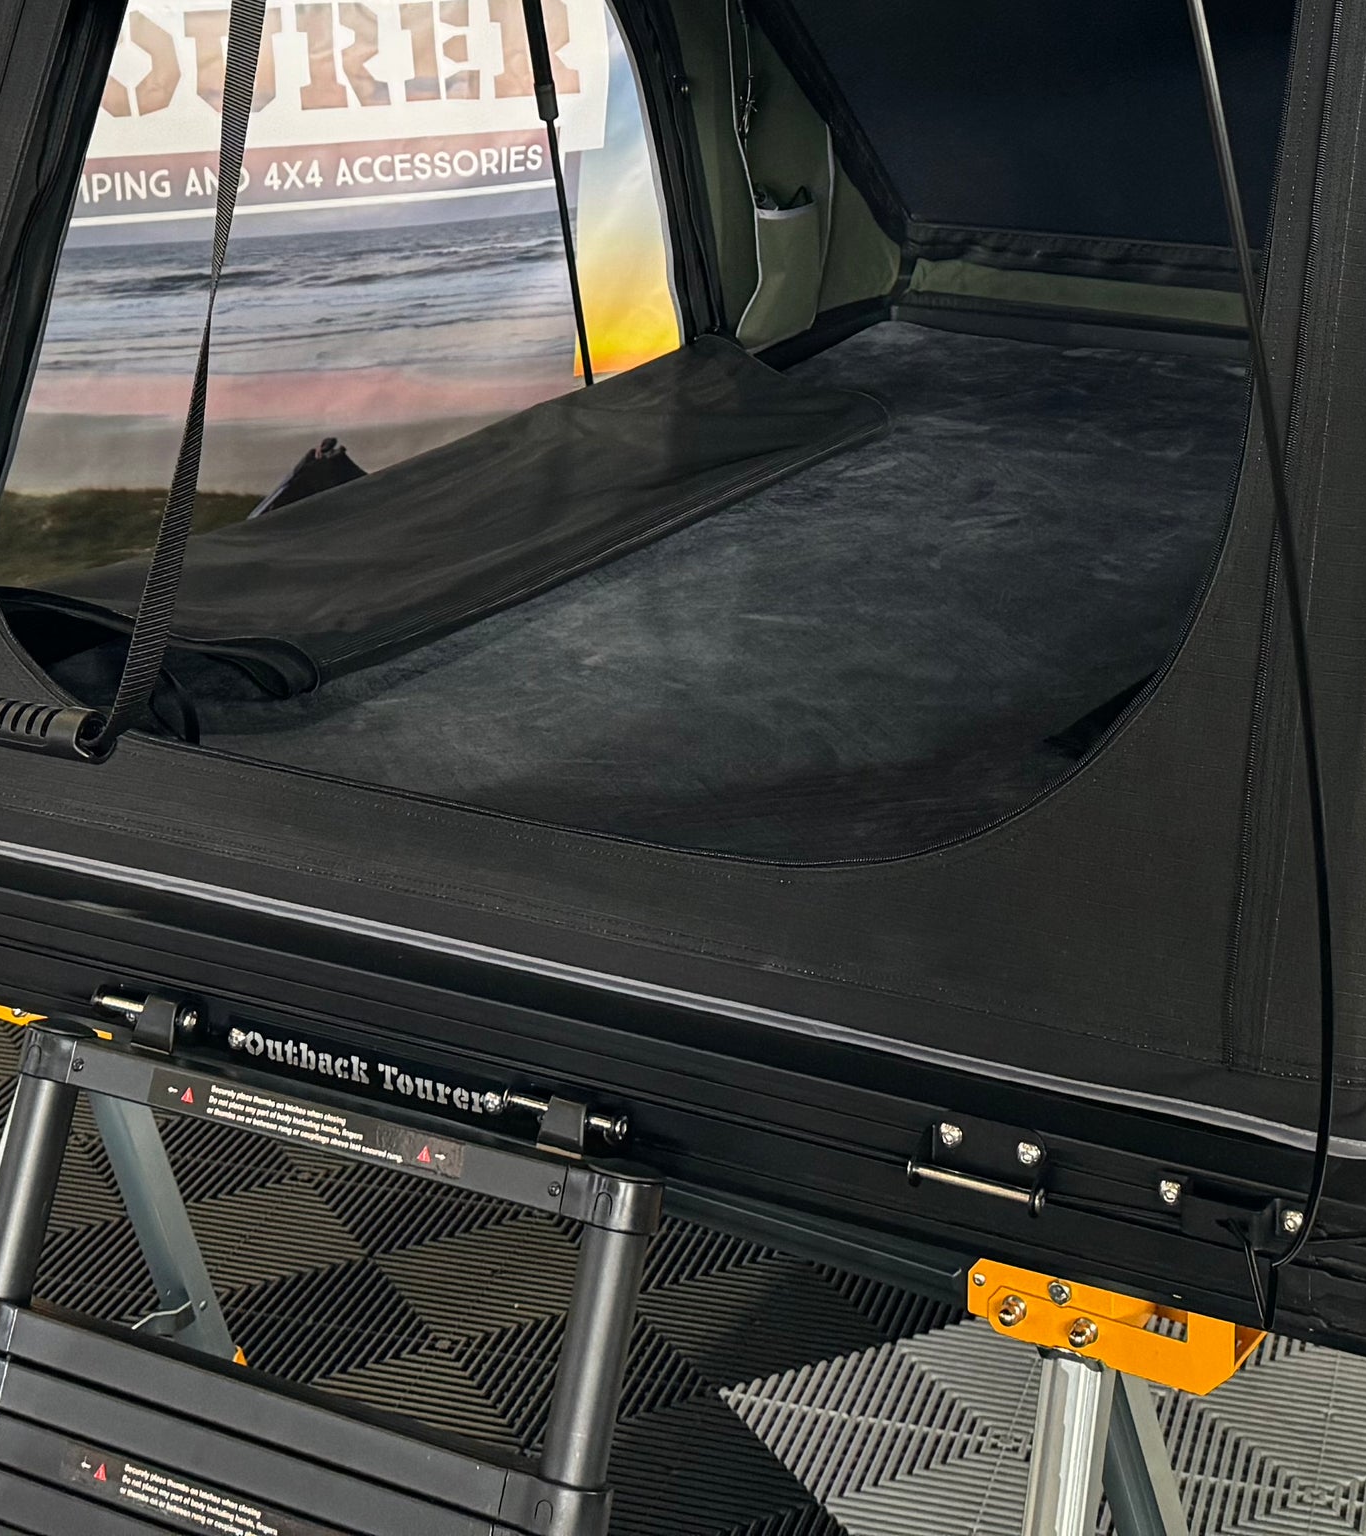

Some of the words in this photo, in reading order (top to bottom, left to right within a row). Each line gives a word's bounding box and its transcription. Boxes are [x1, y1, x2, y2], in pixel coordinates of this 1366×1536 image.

[264, 158, 324, 191] 4X4
[335, 143, 544, 186] ACCESSORIES
[245, 1030, 370, 1085] Outback
[378, 1062, 485, 1114] Tourer
